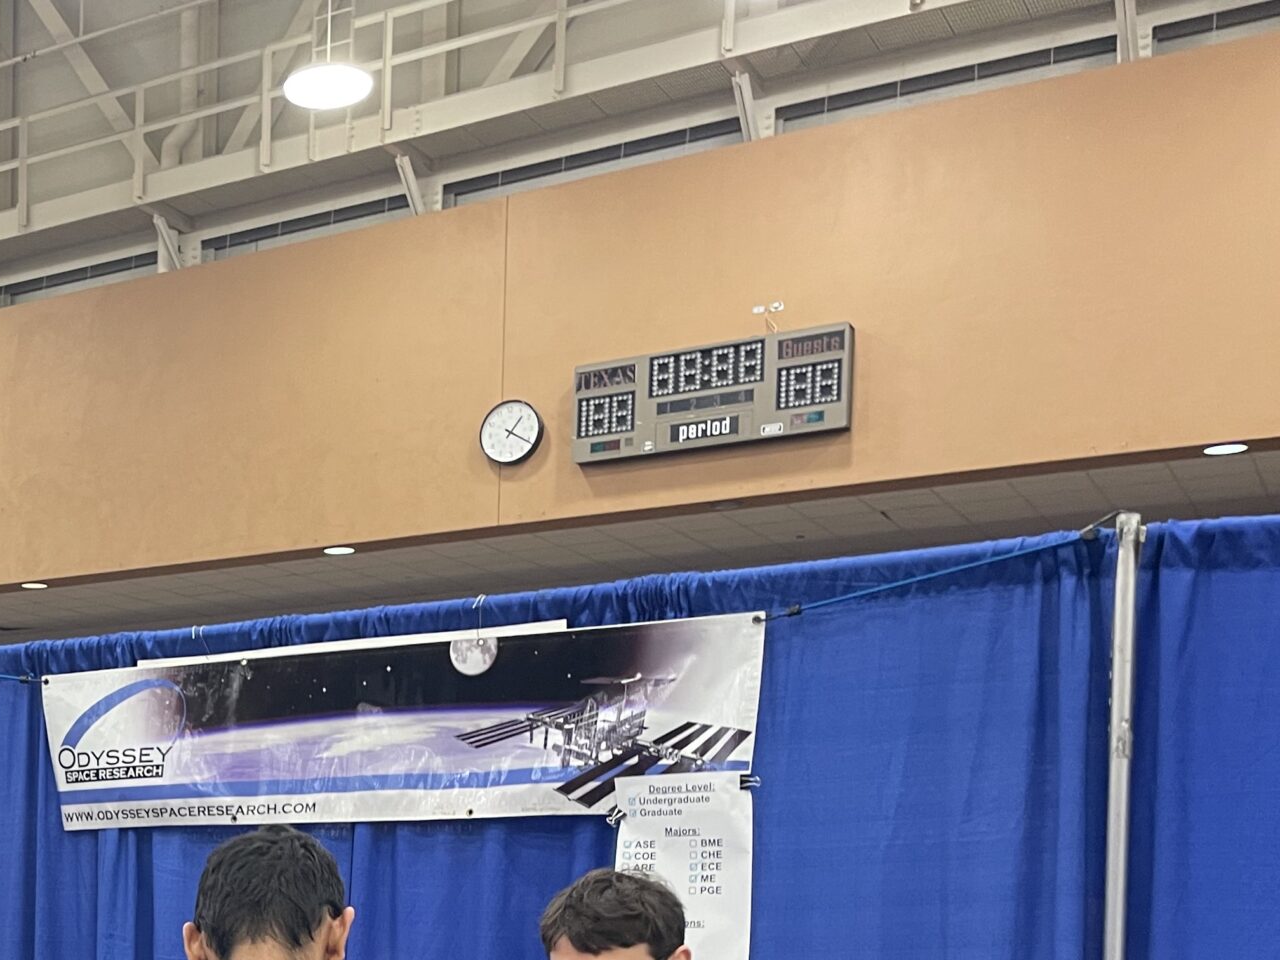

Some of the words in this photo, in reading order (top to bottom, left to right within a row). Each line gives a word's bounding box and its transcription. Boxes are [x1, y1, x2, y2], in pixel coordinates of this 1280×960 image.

[782, 335, 840, 358] Guests
[580, 365, 635, 391] TEXAS
[678, 416, 731, 443] period
[58, 746, 173, 770] ODYSSEY
[66, 769, 98, 782] SPACE
[98, 765, 163, 780] RESEARCH
[648, 784, 683, 795] Degree
[685, 782, 715, 793] Level:
[638, 794, 711, 806] Undergraduate
[64, 802, 317, 823] WWW.ODYSSEYSPACERESEARCH.COM
[640, 808, 683, 817] Graduate
[664, 827, 701, 837] Majors:
[634, 840, 656, 849] ASE
[700, 838, 723, 848] BME
[634, 851, 657, 860] COE
[700, 850, 723, 859] CHE
[701, 862, 722, 871] ECE
[700, 874, 716, 883] ME
[700, 886, 722, 895] PGE
